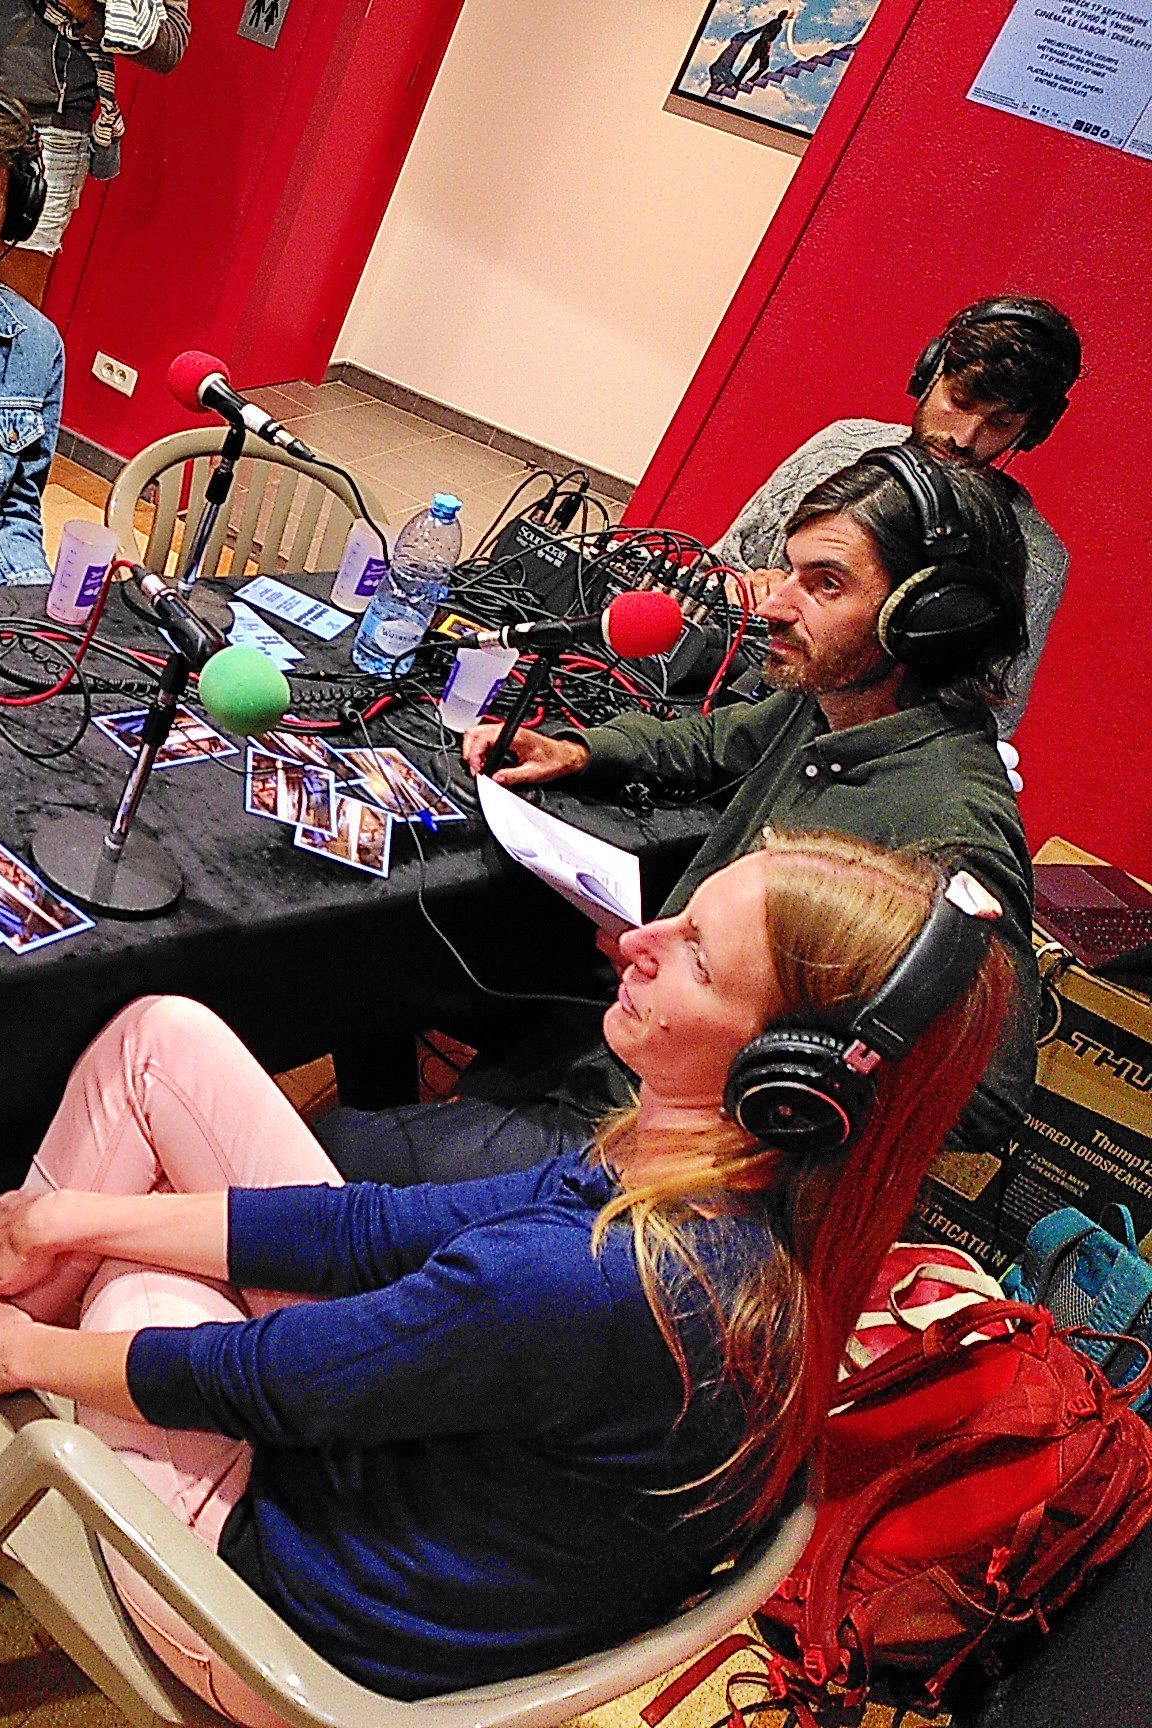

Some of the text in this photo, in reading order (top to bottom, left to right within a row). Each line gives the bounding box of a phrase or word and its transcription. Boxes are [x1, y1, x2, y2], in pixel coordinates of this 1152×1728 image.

[1062, 5, 1074, 15] DE
[1101, 7, 1148, 27] SEPTEMBRE
[1034, 8, 1067, 24] CINÉMA
[1067, 18, 1078, 28] LE
[1078, 22, 1107, 36] LABOR
[1036, 43, 1069, 59] MÉTRAGES
[1043, 37, 1084, 54] PROJECTIONS
[1094, 53, 1119, 66] COURTS
[1027, 65, 1054, 78] PLATEAU
[1054, 74, 1074, 84] RADIO
[1082, 83, 1104, 94] APÉRO
[1034, 76, 1088, 97] ENTRÉE GRATUITE
